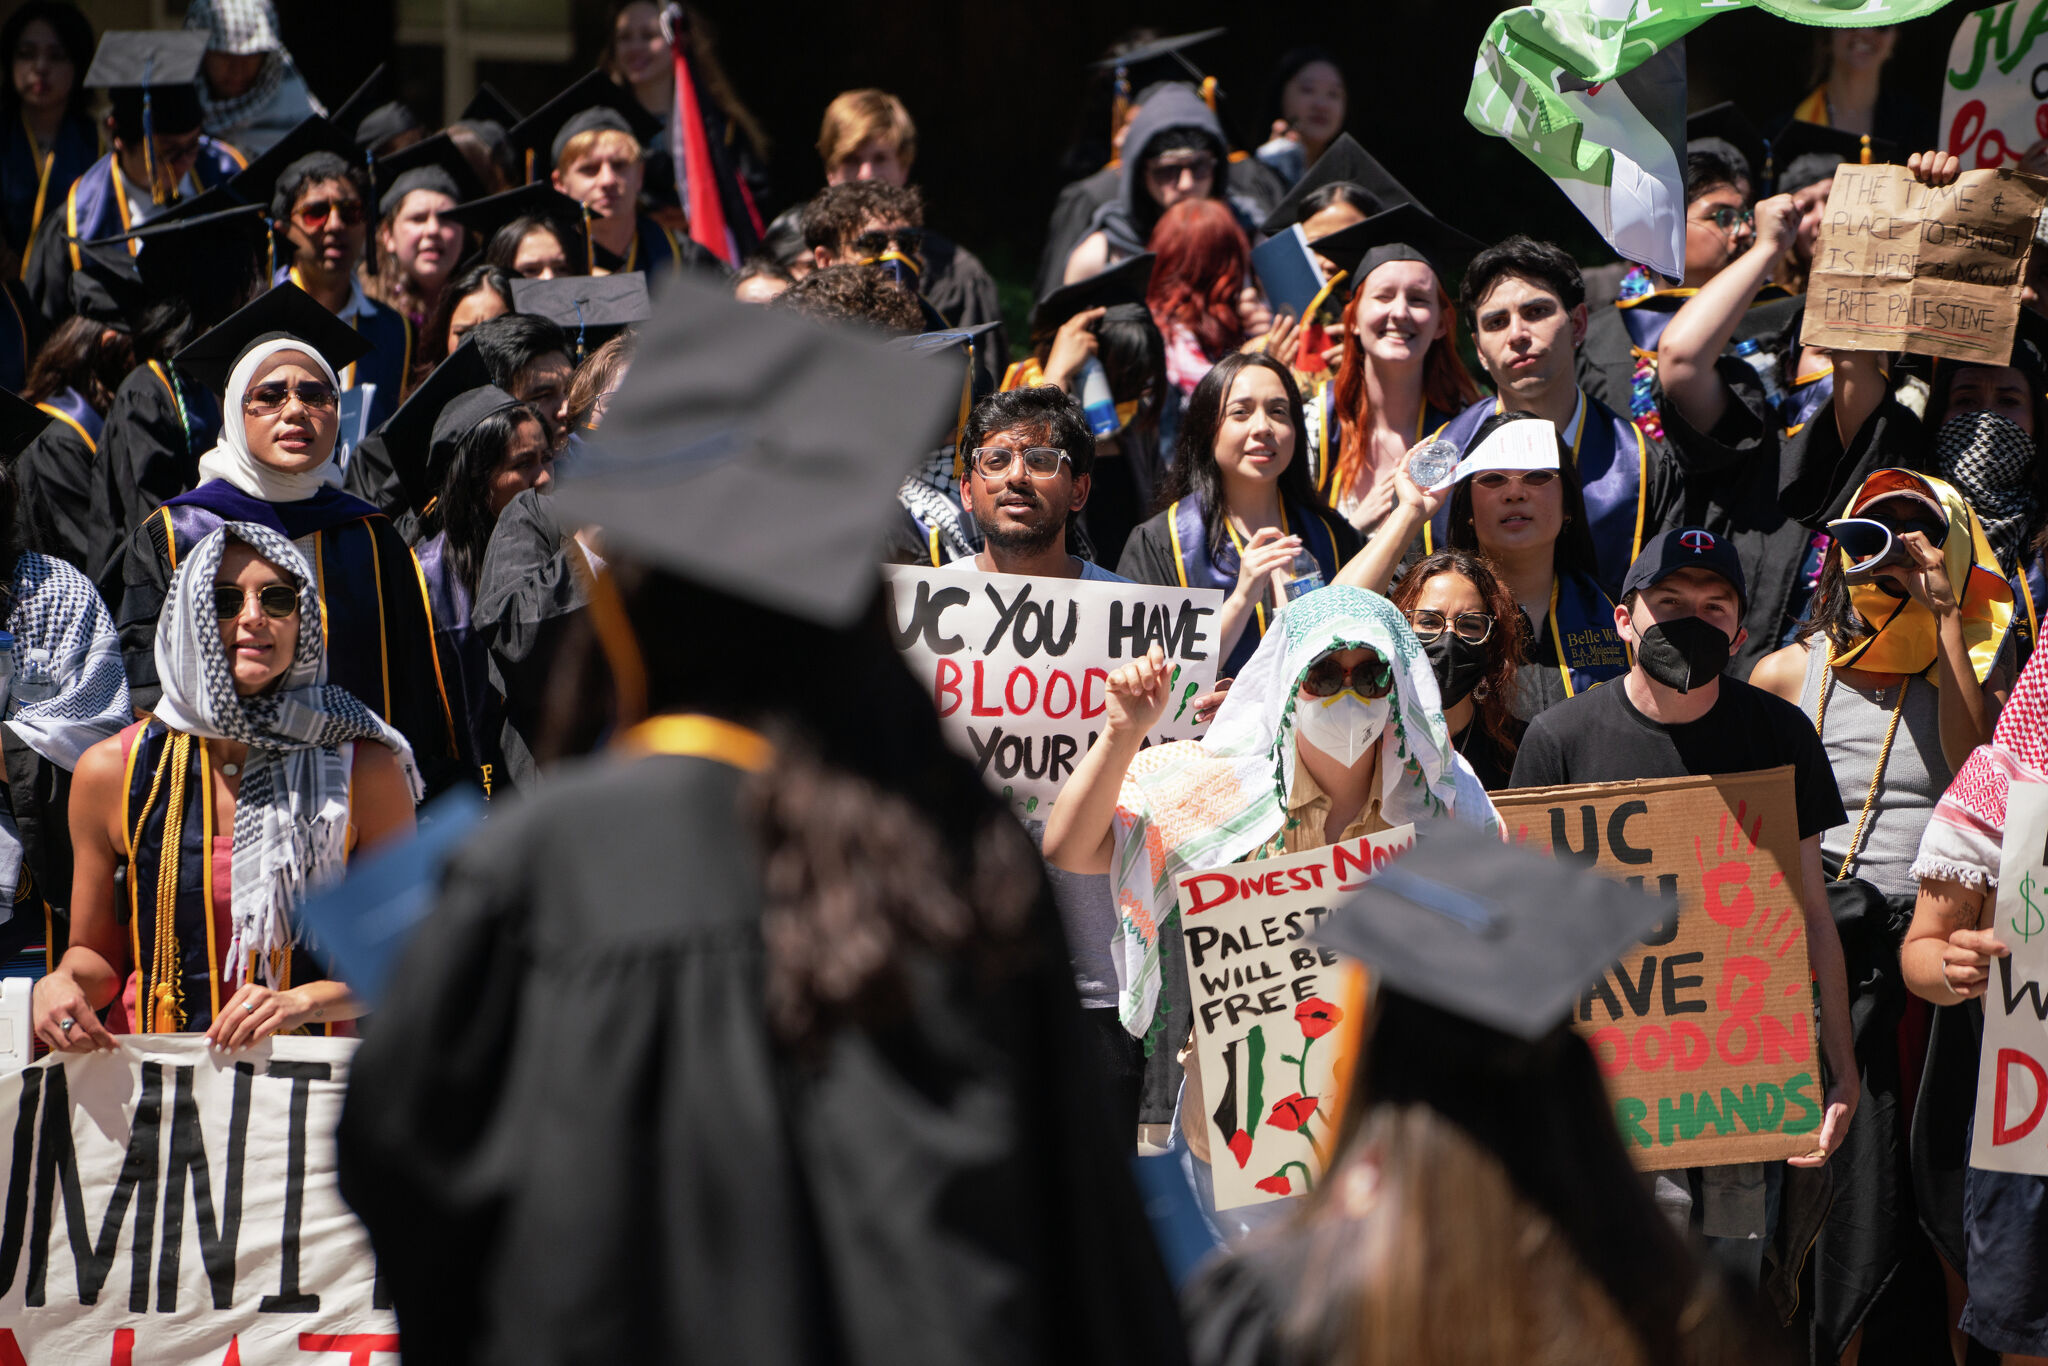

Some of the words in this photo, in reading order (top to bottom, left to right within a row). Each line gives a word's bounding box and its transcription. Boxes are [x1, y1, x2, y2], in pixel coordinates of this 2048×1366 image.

[1841, 173, 1893, 206] THE
[1903, 178, 1978, 213] TIME
[1832, 210, 1904, 240] PLACE
[1919, 218, 1945, 245] TO
[1954, 222, 2022, 257] DIVEST
[1825, 248, 1856, 273] IS
[1874, 252, 1922, 278] HERE
[1825, 288, 1880, 324] FREE
[1888, 294, 1995, 333] PALESTINE
[982, 583, 1080, 659] YOU
[1108, 599, 1214, 661] HAVE
[1567, 629, 1600, 647] Belle
[1572, 656, 1585, 668] and
[1586, 655, 1600, 666] Cell
[1601, 654, 1625, 668] Biology
[1588, 644, 1621, 656] Molecular
[934, 658, 1108, 720] BLOOD
[966, 726, 1077, 782] YOUR
[1547, 800, 1653, 869] UC
[1179, 862, 1328, 917] DIVEST
[1183, 906, 1342, 969] PALEST
[1200, 961, 1283, 996] WILL
[1293, 945, 1339, 972] BE
[1572, 951, 1708, 1025] AVE
[1200, 974, 1319, 1035] FREE
[1588, 1020, 1711, 1079] OOD
[1715, 1012, 1811, 1067] ON
[1658, 1072, 1822, 1147] HANDS
